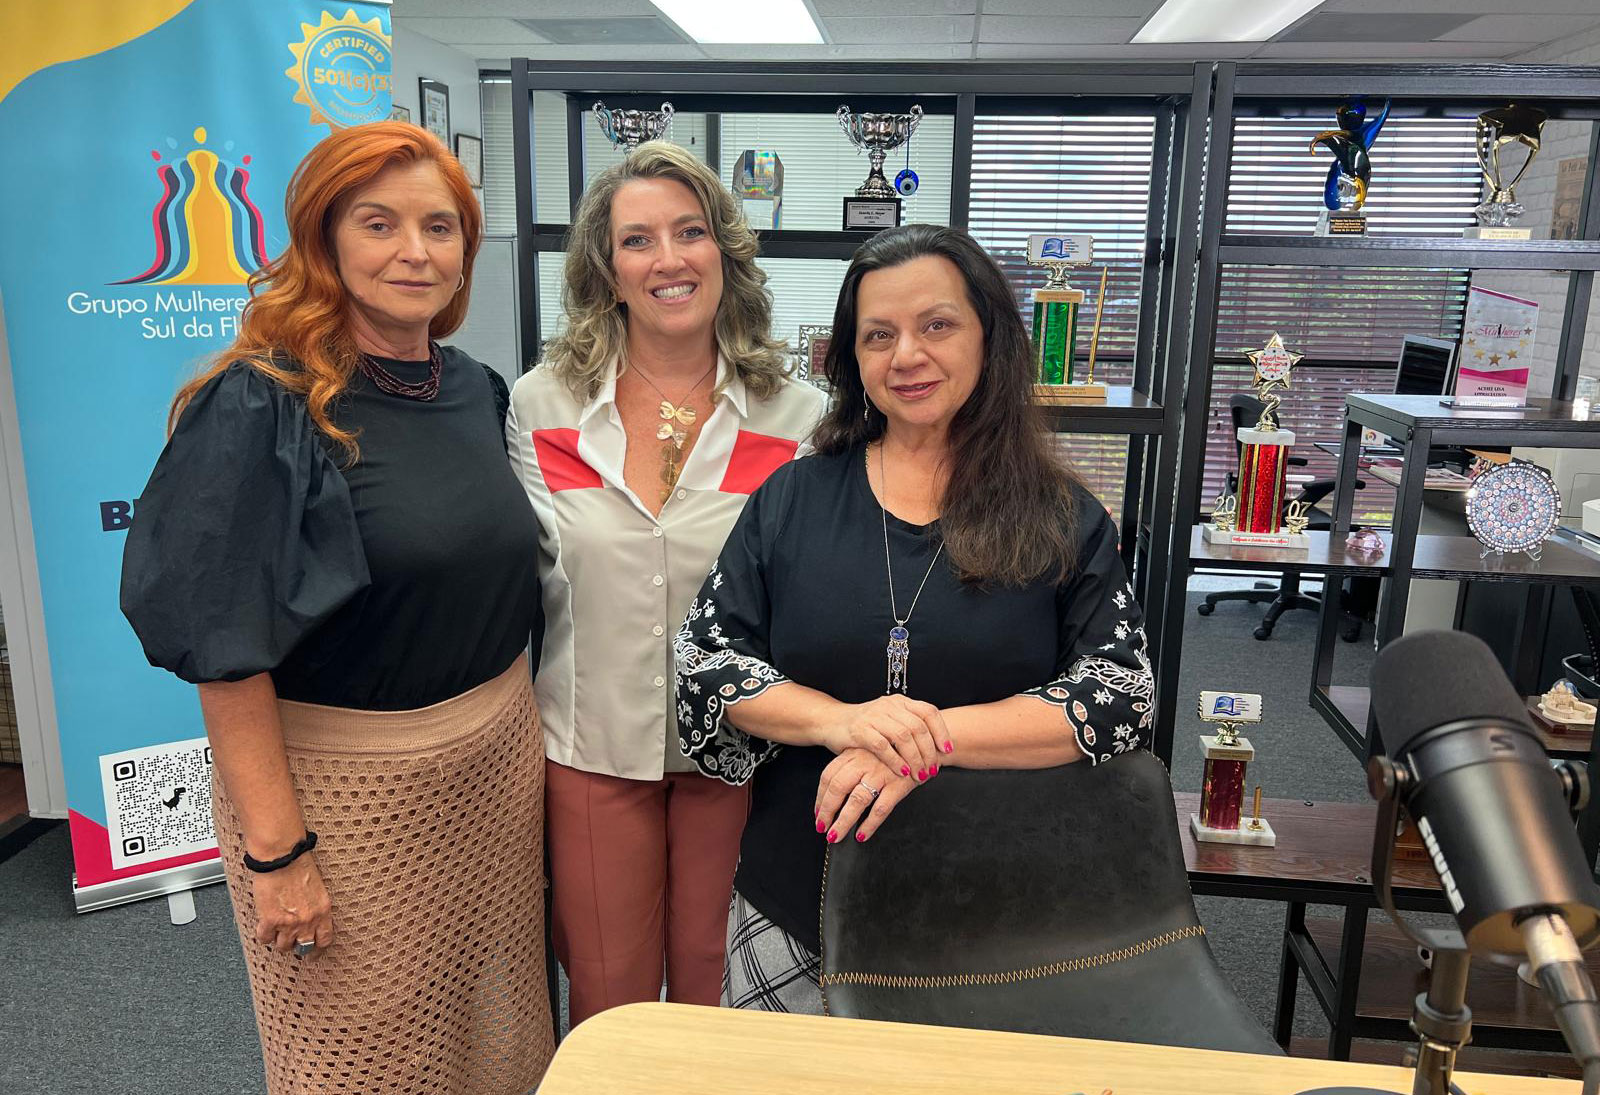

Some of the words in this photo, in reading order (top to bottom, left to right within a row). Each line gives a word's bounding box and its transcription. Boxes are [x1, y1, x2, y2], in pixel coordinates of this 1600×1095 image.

[320, 36, 385, 63] CERTIFIED
[67, 292, 148, 318] Grupo
[154, 290, 250, 312] Mulhere
[141, 317, 176, 339] Sul
[183, 316, 213, 338] da
[220, 315, 241, 337] Fl
[99, 499, 139, 531] B
[1215, 495, 1236, 514] 20
[1418, 816, 1465, 914] SHURE
